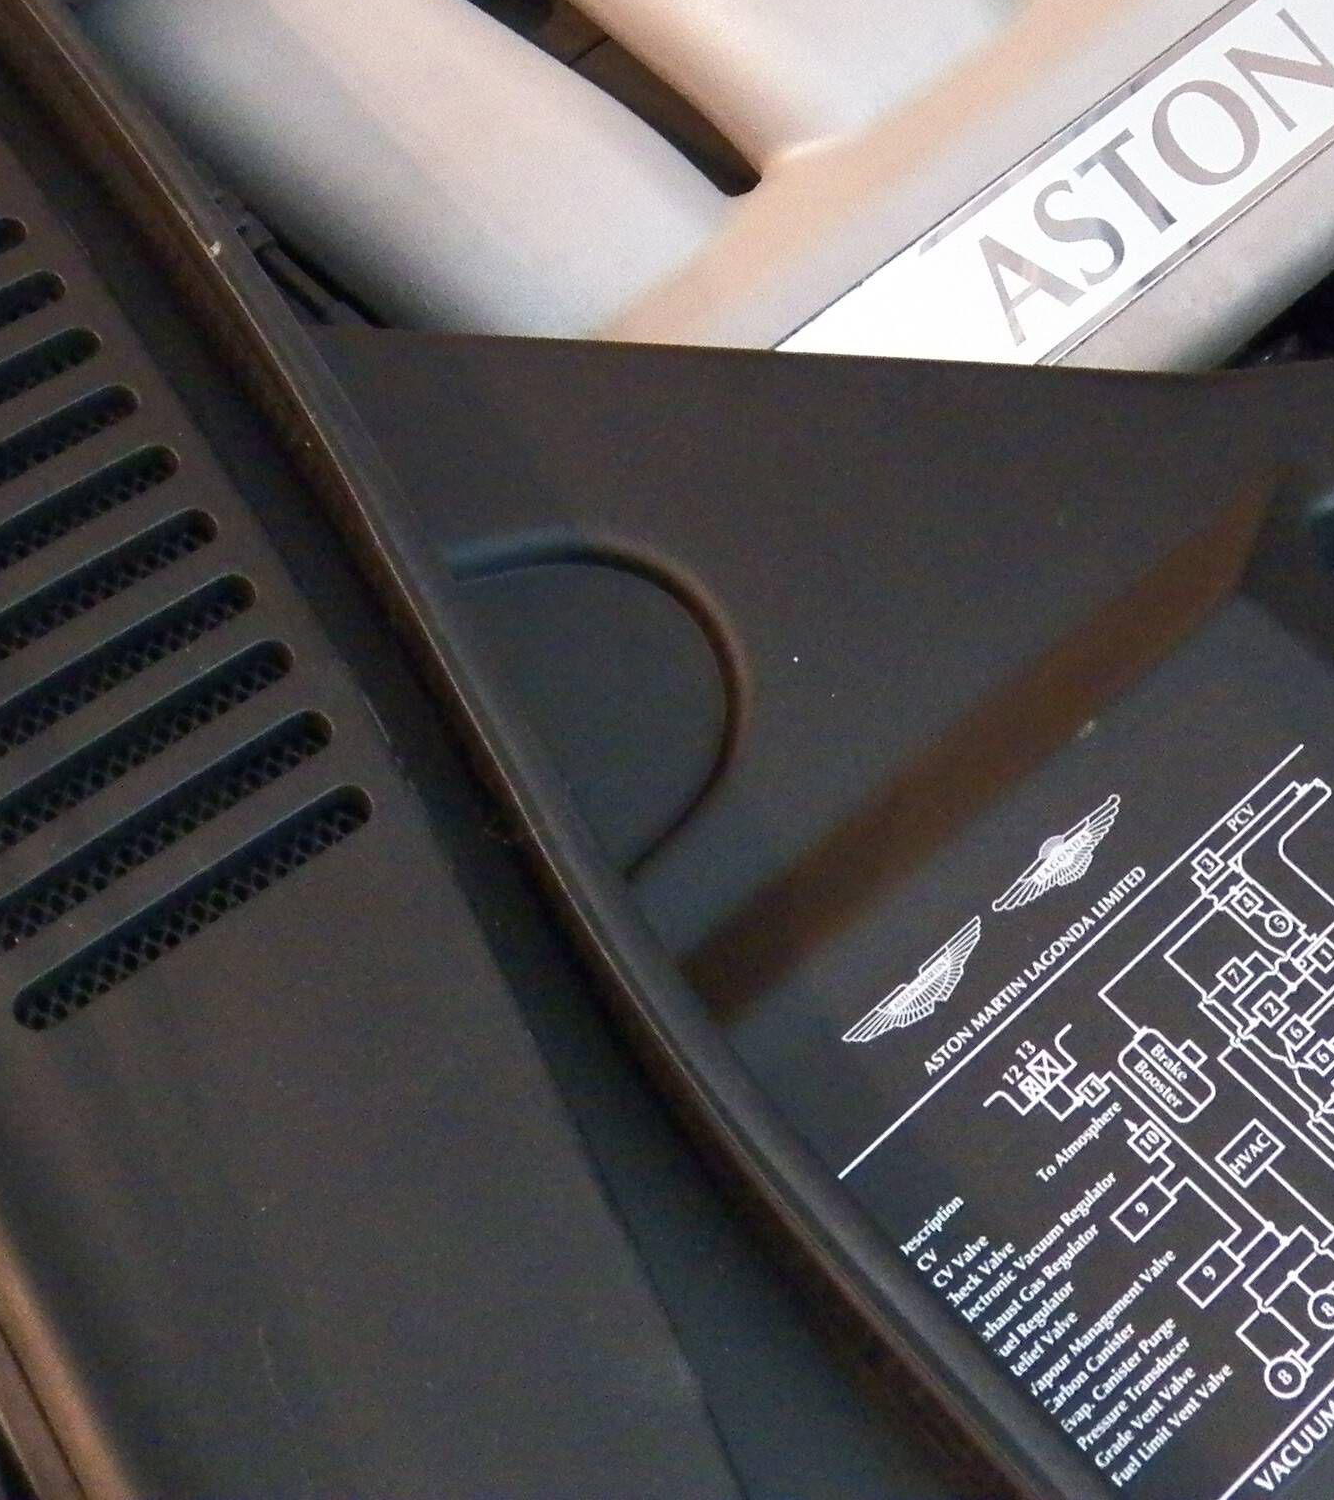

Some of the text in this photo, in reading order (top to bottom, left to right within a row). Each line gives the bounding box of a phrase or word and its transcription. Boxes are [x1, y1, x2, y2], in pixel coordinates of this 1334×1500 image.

[1226, 803, 1254, 832] PCV
[1033, 827, 1091, 885] LAGONDA
[1200, 857, 1214, 871] 3
[1242, 896, 1253, 908] 4
[1273, 916, 1286, 930] 5
[1320, 948, 1332, 960] 1
[924, 866, 1145, 1075] ASTON MARTIN LAGONDA LIMITED
[1227, 967, 1239, 982] 7
[1263, 1001, 1278, 1016] 2
[1289, 1025, 1303, 1039] 6
[1015, 1040, 1035, 1059] 13
[1150, 1043, 1187, 1081] Brake
[1316, 1050, 1329, 1063] 6
[1002, 1064, 1023, 1084] 12
[1082, 1079, 1103, 1098] 11
[1133, 1059, 1182, 1107] Booster
[1035, 1101, 1121, 1181] To Atmosphere
[1138, 1130, 1159, 1150] 10
[1229, 1132, 1270, 1175] HVAC
[1012, 1224, 1064, 1269] Vacuum
[1059, 1172, 1115, 1226] Regulator
[1134, 1201, 1148, 1216] 9
[950, 1236, 988, 1267] Valve
[946, 1242, 1014, 1307] heck Valve
[982, 1223, 1098, 1340] xhaust Gas Regulator
[1202, 1265, 1216, 1280] 9
[994, 1281, 1073, 1356] uel Regulator
[1068, 1280, 1144, 1356] Management
[1138, 1250, 1175, 1282] Valve
[1320, 1301, 1334, 1316] 8
[1040, 1312, 1077, 1344] Valve
[1085, 1323, 1134, 1372] Canister
[1092, 1351, 1141, 1400] Canister
[1138, 1318, 1175, 1354] Purge
[1277, 1369, 1292, 1385] 8
[1076, 1336, 1189, 1451] Pressure Transducer
[1094, 1367, 1195, 1467] Grade Vent Valve
[1110, 1364, 1232, 1487] Fuel Limit Vent Valve
